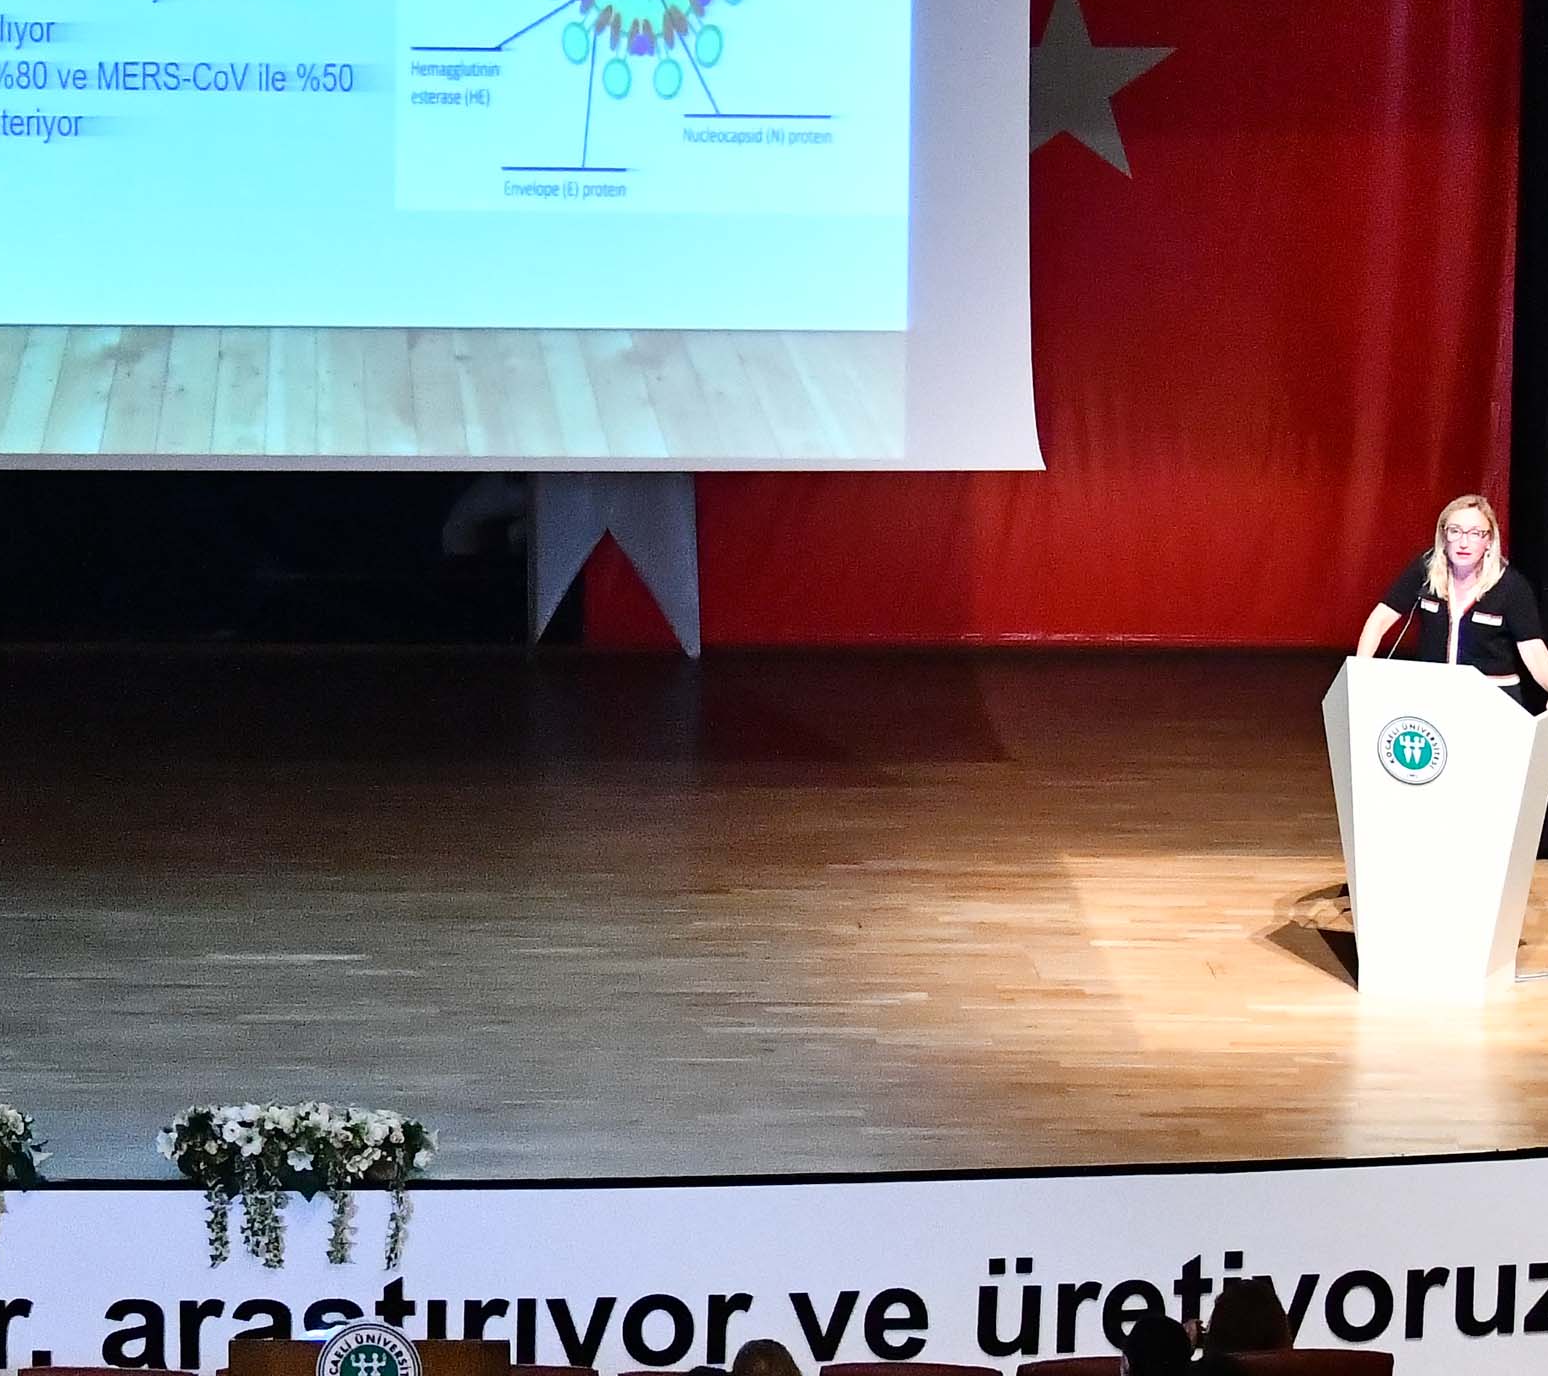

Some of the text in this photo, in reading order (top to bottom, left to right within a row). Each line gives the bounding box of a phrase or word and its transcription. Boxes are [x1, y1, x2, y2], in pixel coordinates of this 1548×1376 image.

[57, 67, 87, 90] ve
[96, 61, 247, 91] MERS-CoV
[257, 62, 287, 91] ile
[296, 61, 353, 91] %50
[411, 61, 501, 79] Hemagglutinin
[411, 89, 491, 107] esterase (HE)
[683, 127, 833, 146] Nucleocapsid (N) protein
[504, 180, 559, 198] Envelope
[583, 182, 627, 199] protein
[789, 1287, 929, 1362] ve
